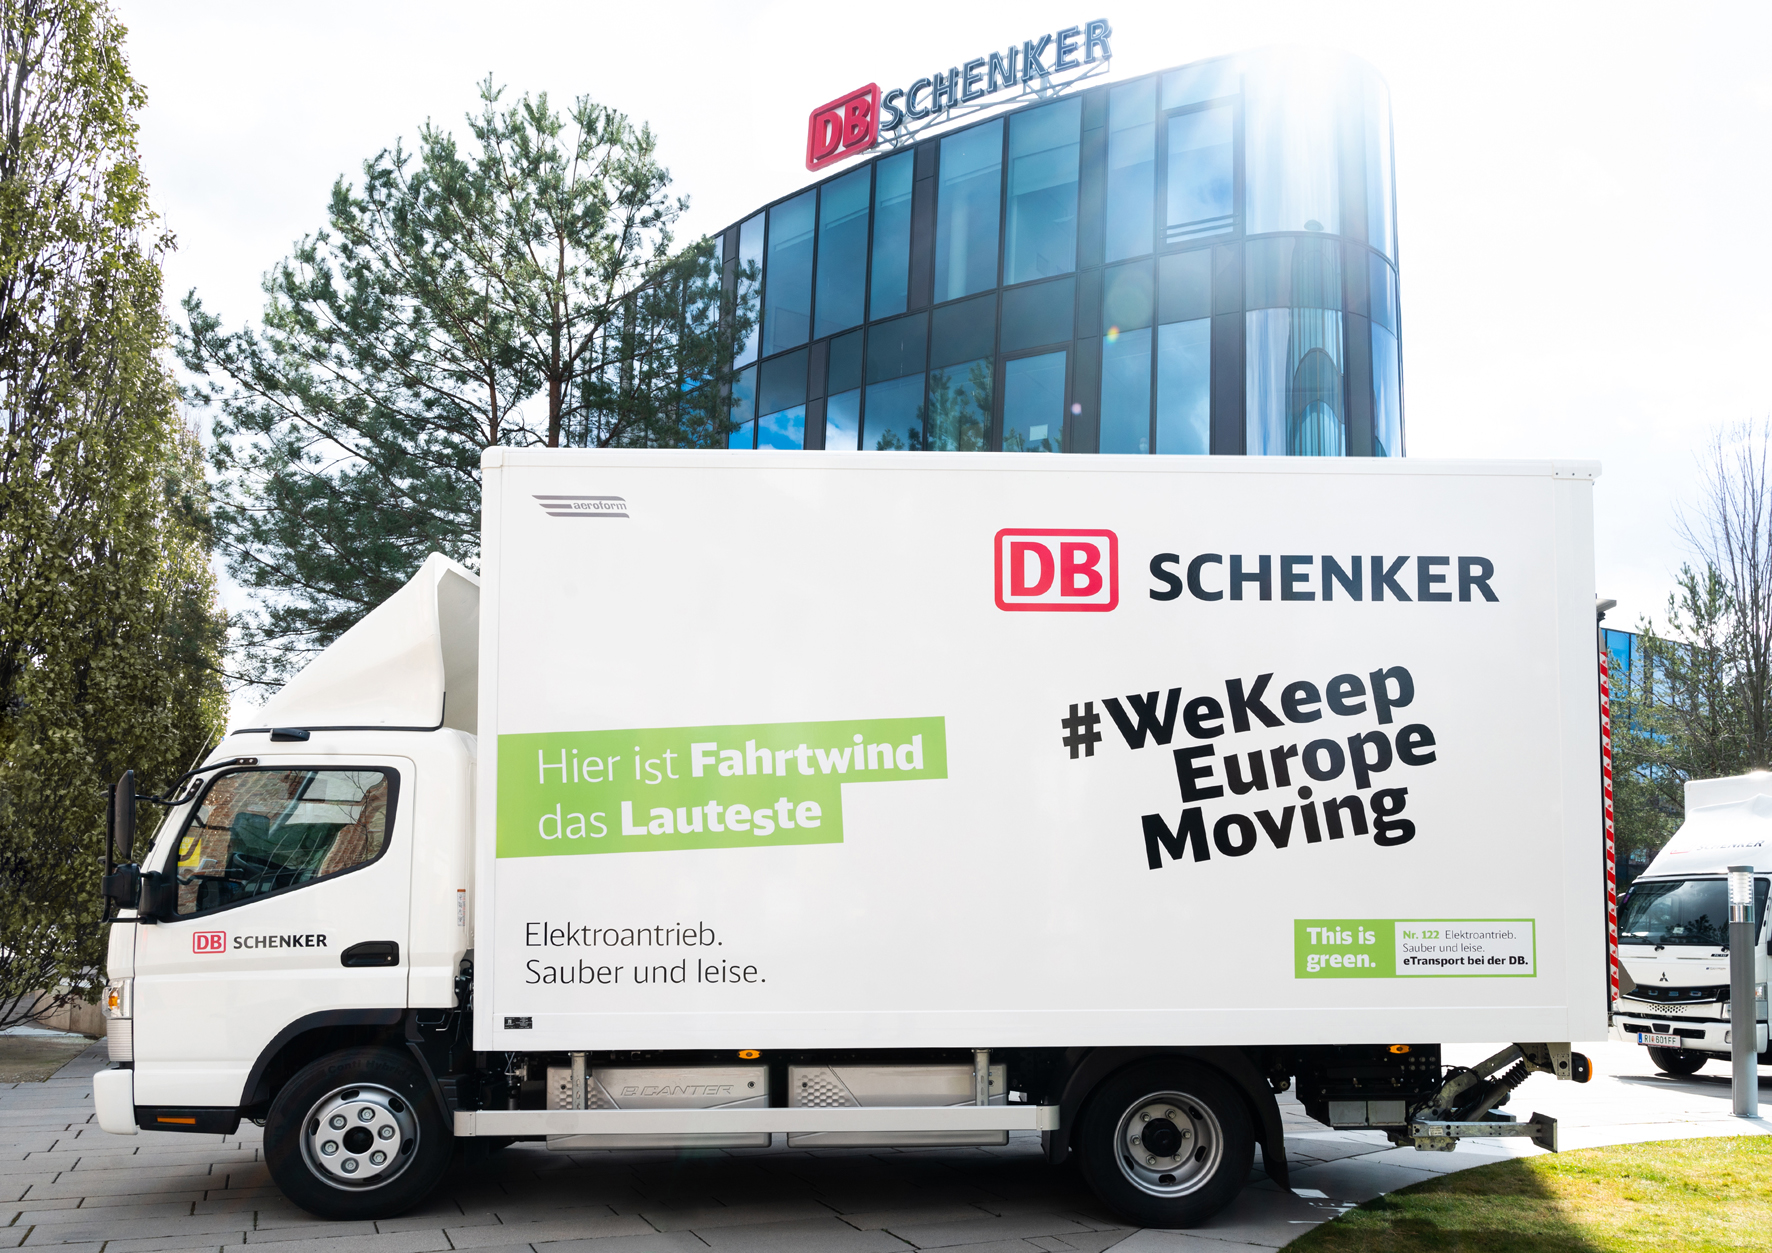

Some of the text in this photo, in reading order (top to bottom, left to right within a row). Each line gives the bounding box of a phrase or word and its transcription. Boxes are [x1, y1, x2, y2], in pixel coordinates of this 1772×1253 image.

[813, 18, 1113, 162] DB SCHENKER
[573, 500, 627, 510] aeroform
[1008, 539, 1500, 602] DB SCHENKER
[1061, 665, 1415, 760] #WeKeep
[538, 733, 924, 785] Hier ist Fahrtwind
[1173, 723, 1437, 803] Europe
[538, 797, 823, 840] das Lauteste
[1141, 785, 1416, 870] Moving
[196, 933, 328, 951] DB SCHENKER
[526, 920, 723, 947] Elektroantrieb.
[1306, 926, 1376, 945] This is
[1402, 930, 1517, 940] Nr. 122 Elektroantrieb.
[1402, 943, 1485, 953] Sauber und leise.
[525, 958, 766, 984] Sauber und leise.
[1306, 953, 1377, 973] green.
[1403, 955, 1529, 968] eTransport bei der DB.
